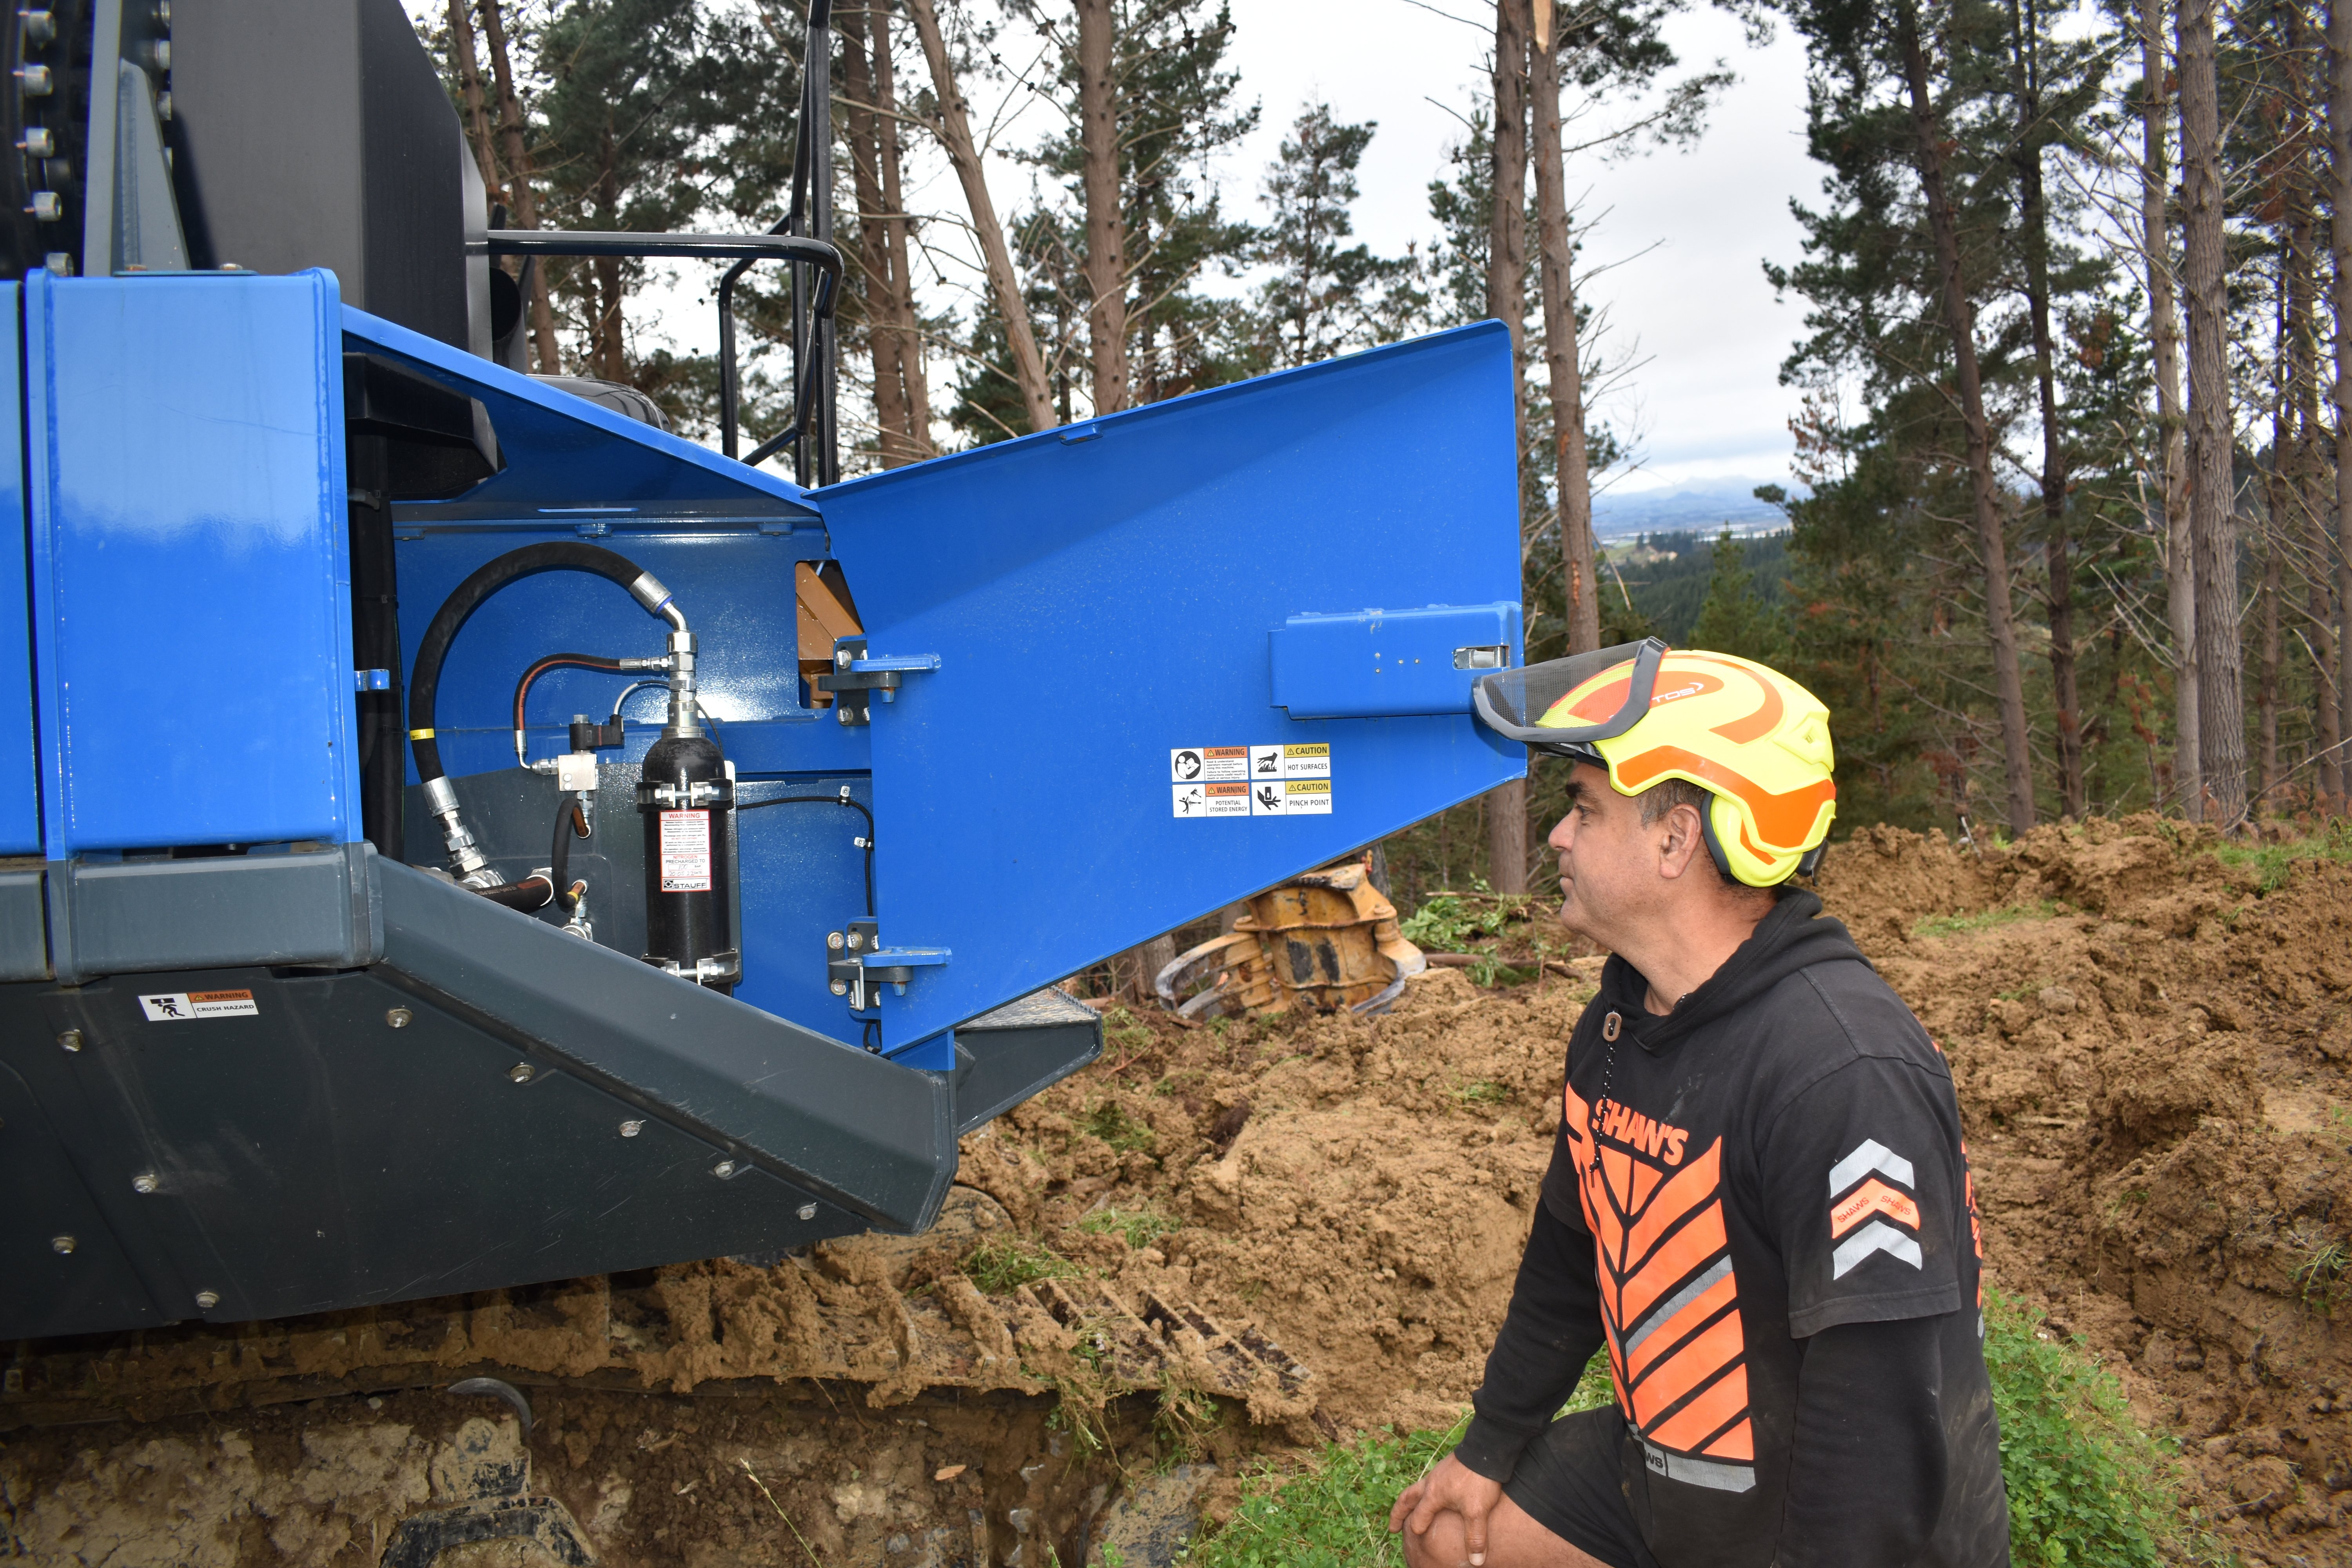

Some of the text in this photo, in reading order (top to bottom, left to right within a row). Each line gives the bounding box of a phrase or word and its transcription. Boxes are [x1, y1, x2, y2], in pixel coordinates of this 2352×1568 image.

[1215, 748, 1245, 756] WARNING
[1295, 746, 1327, 755] CAUTION
[1216, 786, 1246, 794] WARNING
[1297, 783, 1328, 791] CAUTION
[1592, 1098, 1689, 1166] SHAW'S
[1837, 1195, 1911, 1223] SHAWS SHAWS
